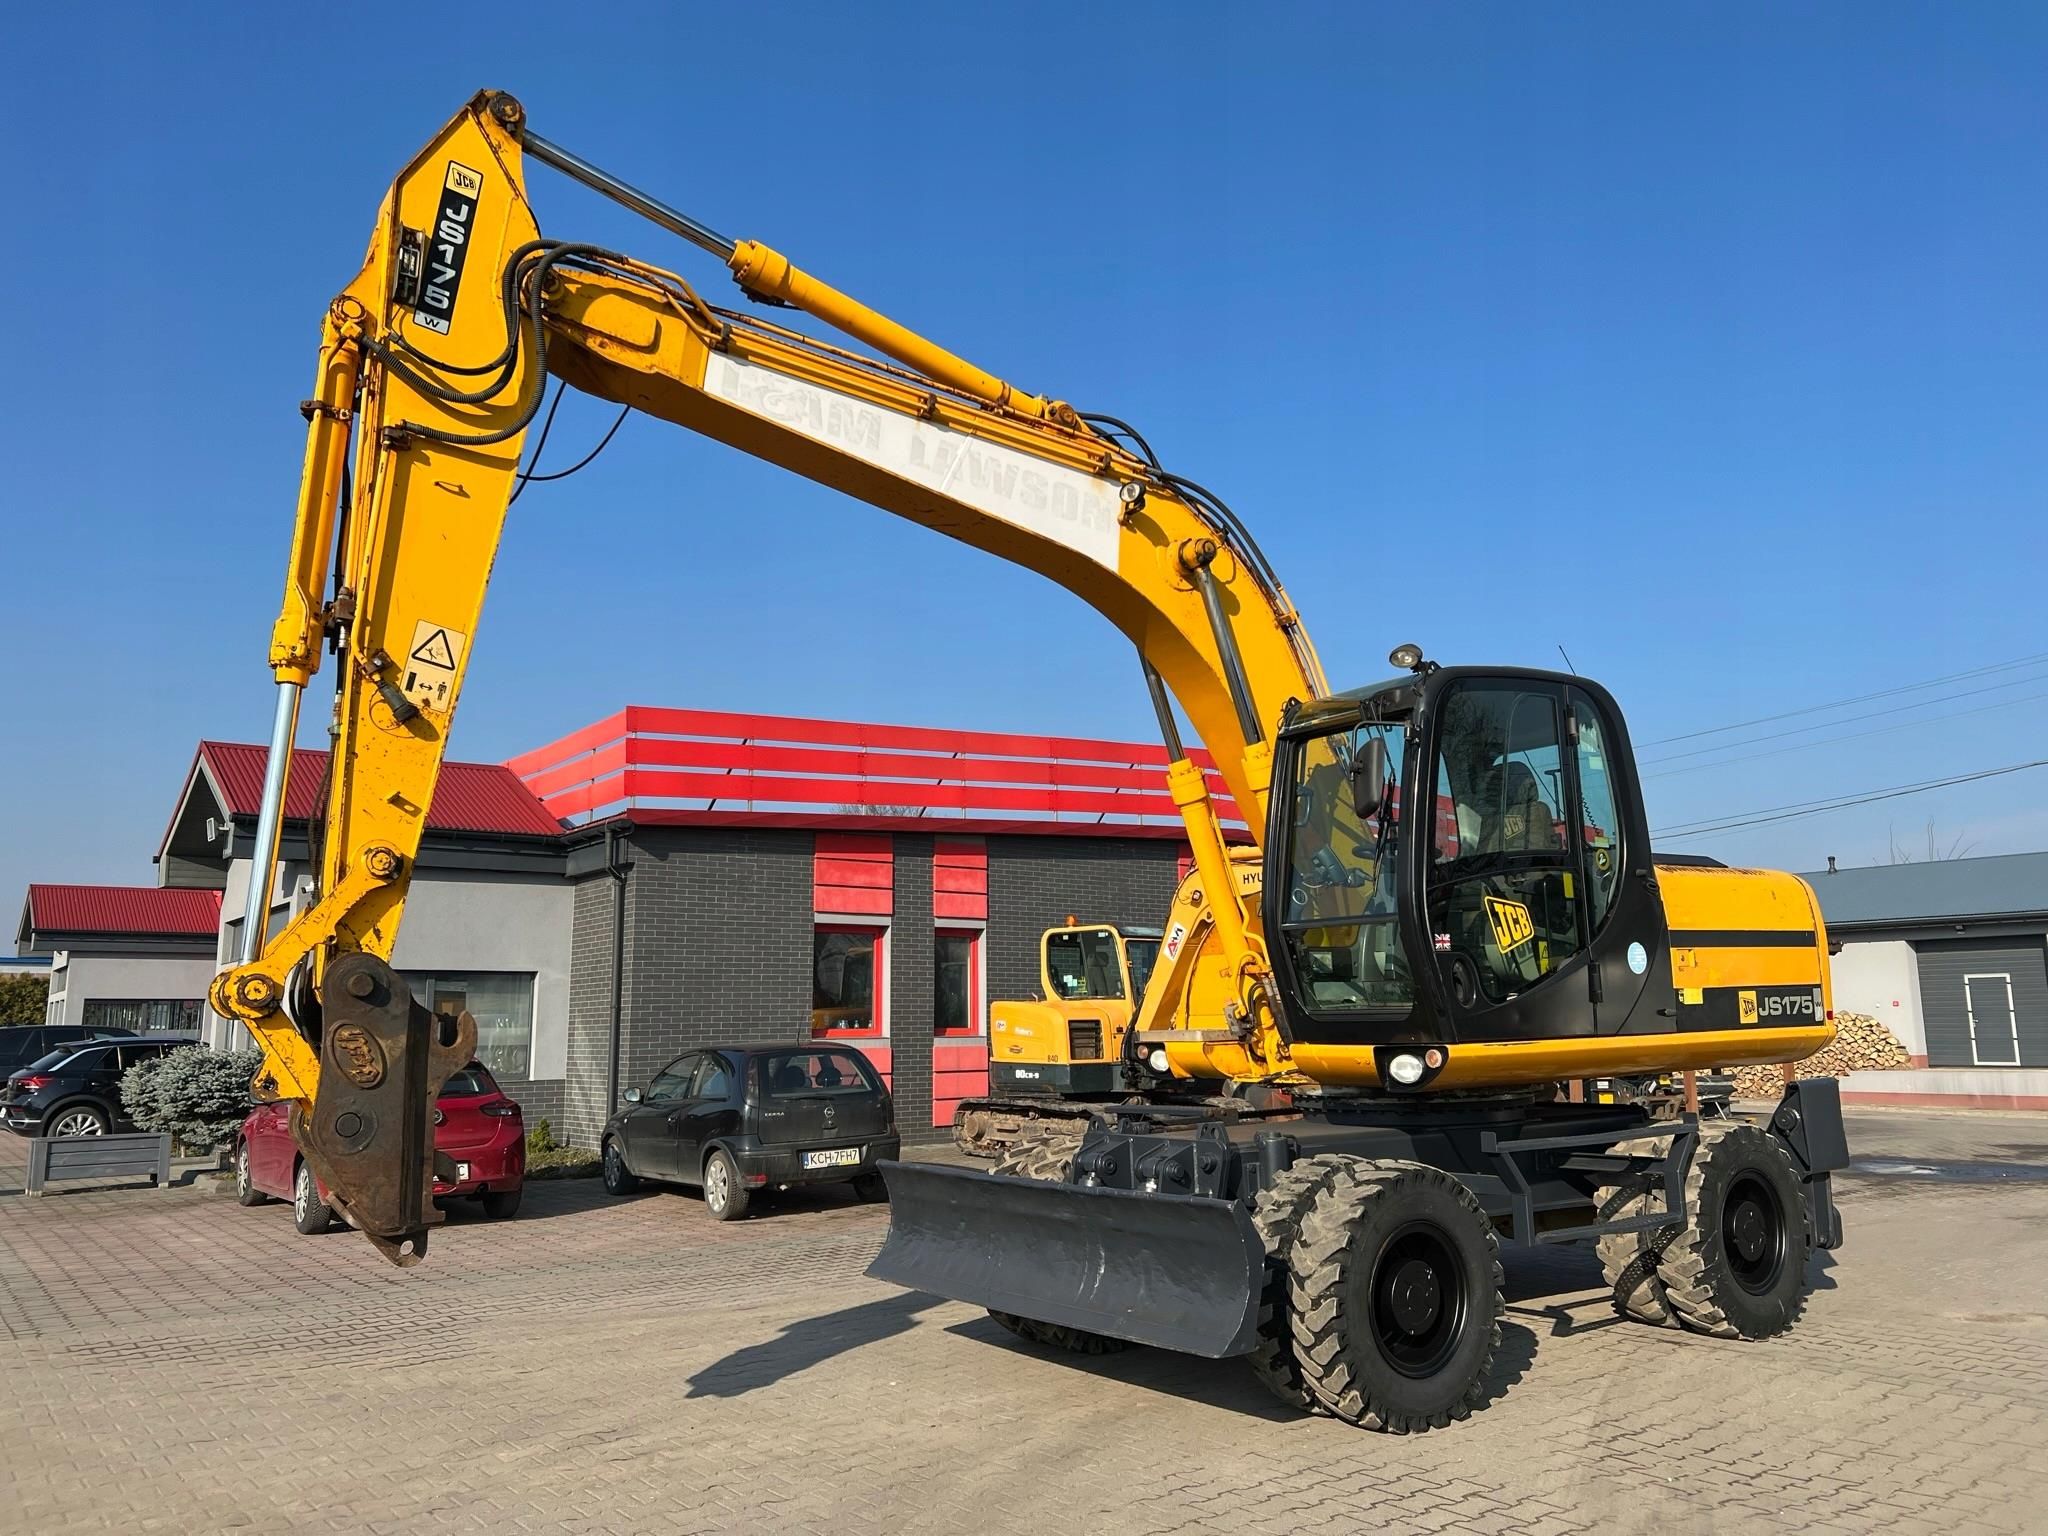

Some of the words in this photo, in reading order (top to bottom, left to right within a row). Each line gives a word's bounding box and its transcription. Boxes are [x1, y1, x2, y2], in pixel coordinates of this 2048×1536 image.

[455, 172, 475, 189] JCB
[424, 204, 470, 310] JS175
[424, 316, 439, 328] W
[1505, 816, 1525, 835] JCB
[1493, 902, 1532, 947] JCB
[1743, 999, 1756, 1014] JCB
[1758, 995, 1813, 1016] JS175
